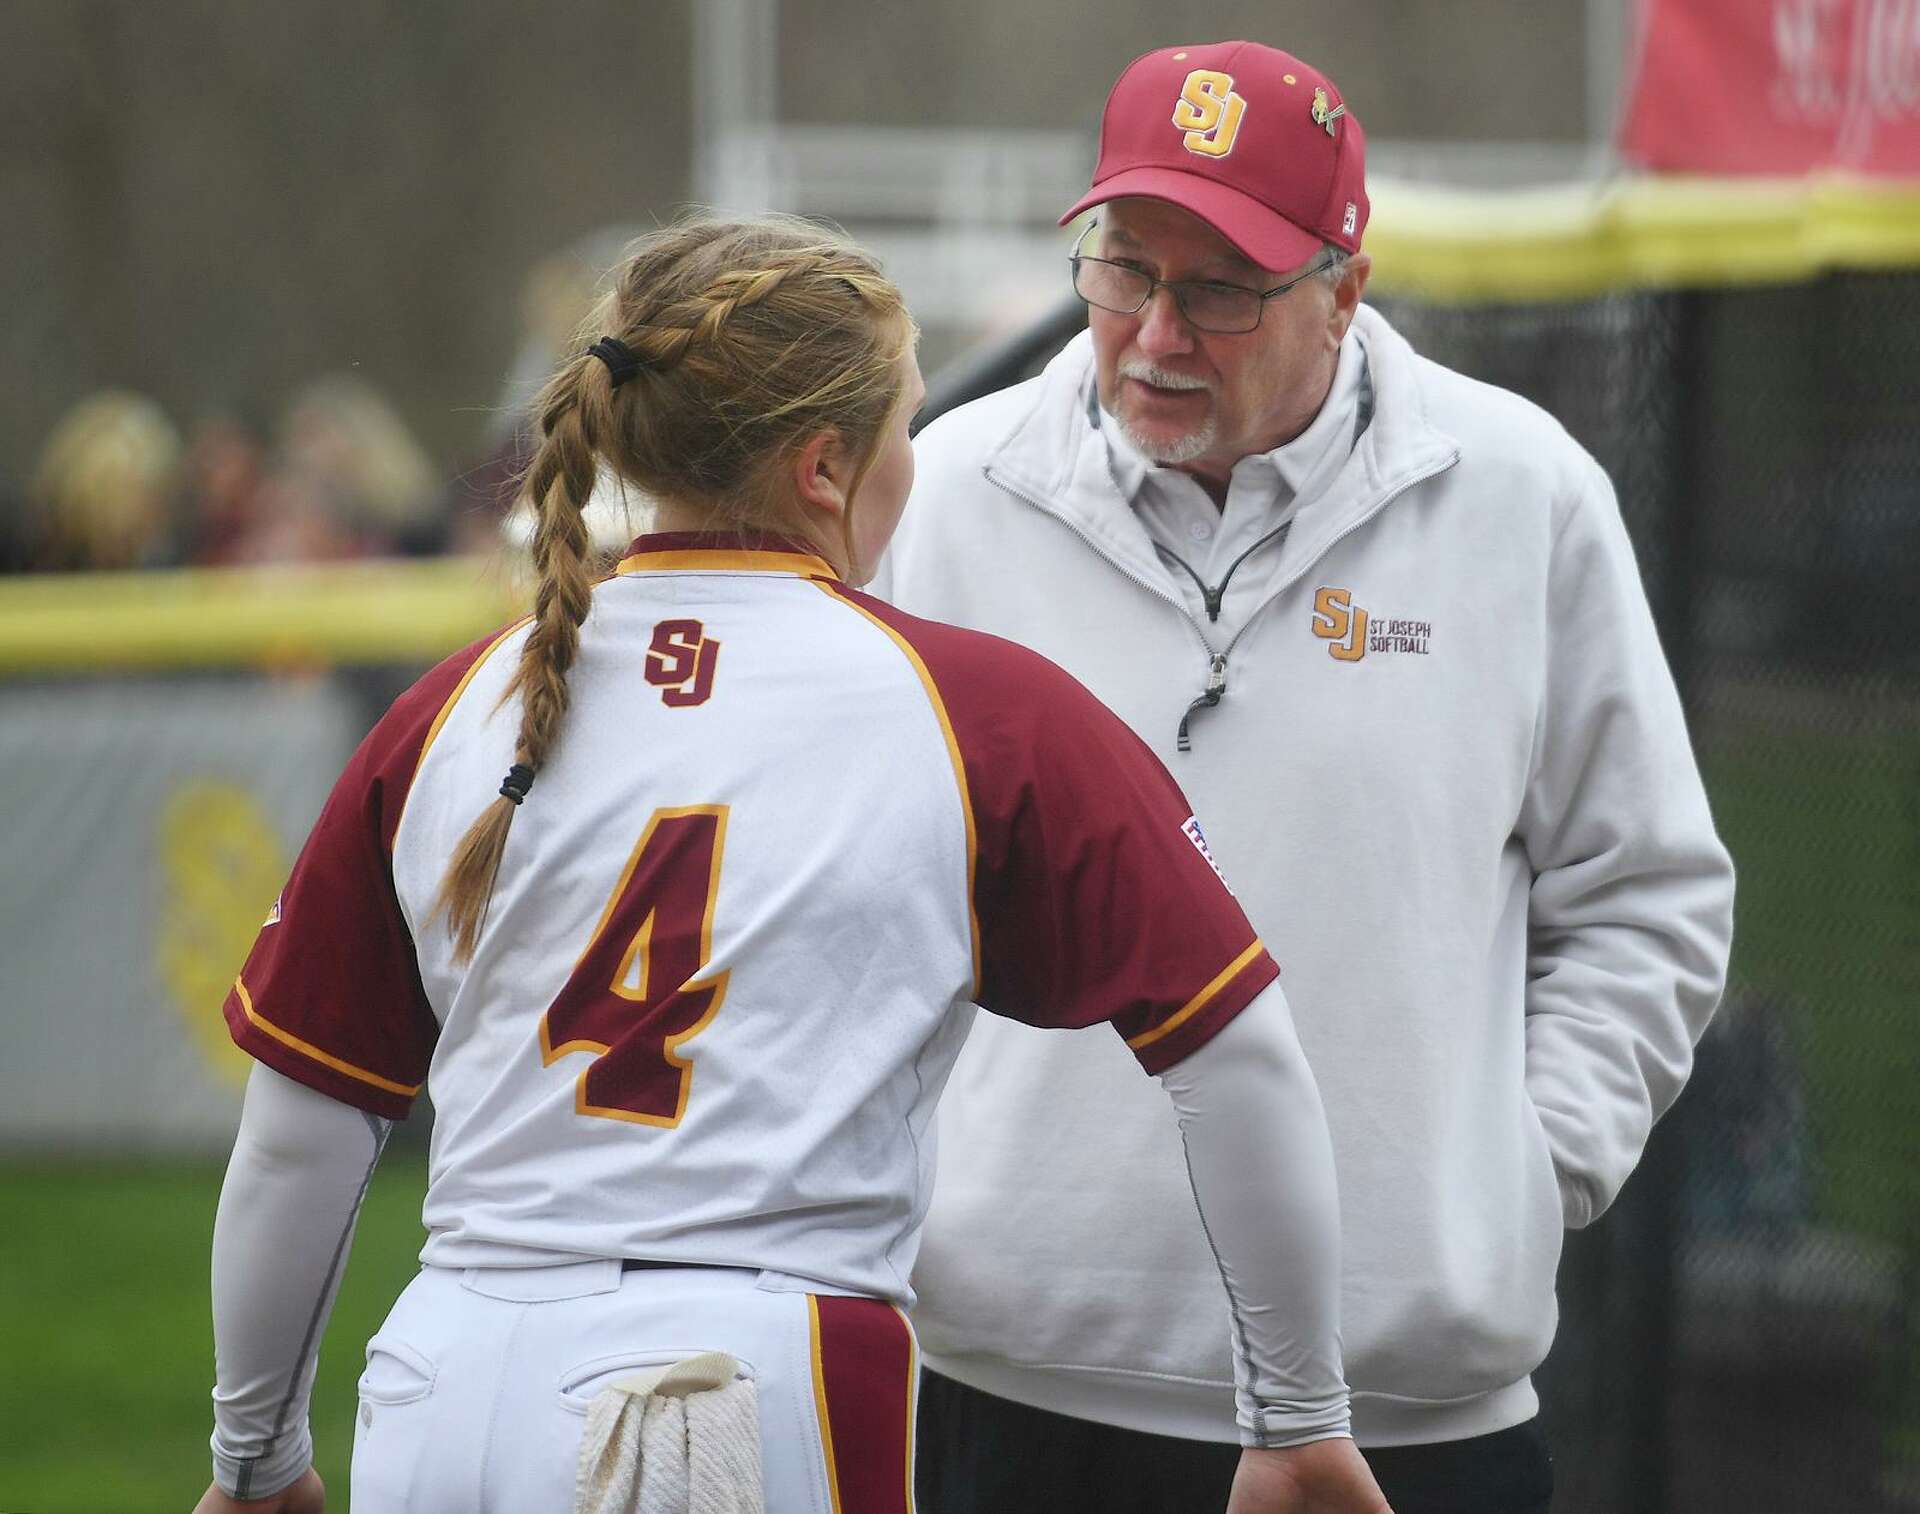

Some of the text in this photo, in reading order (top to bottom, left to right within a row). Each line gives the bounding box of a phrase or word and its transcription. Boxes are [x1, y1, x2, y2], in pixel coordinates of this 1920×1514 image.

[1172, 69, 1248, 160] SJ
[644, 618, 721, 709] SJ
[1312, 586, 1369, 662] SJ
[1369, 619, 1432, 638] ST JOSEPH
[1369, 636, 1430, 655] SOFTBALL
[538, 803, 732, 1130] 4
